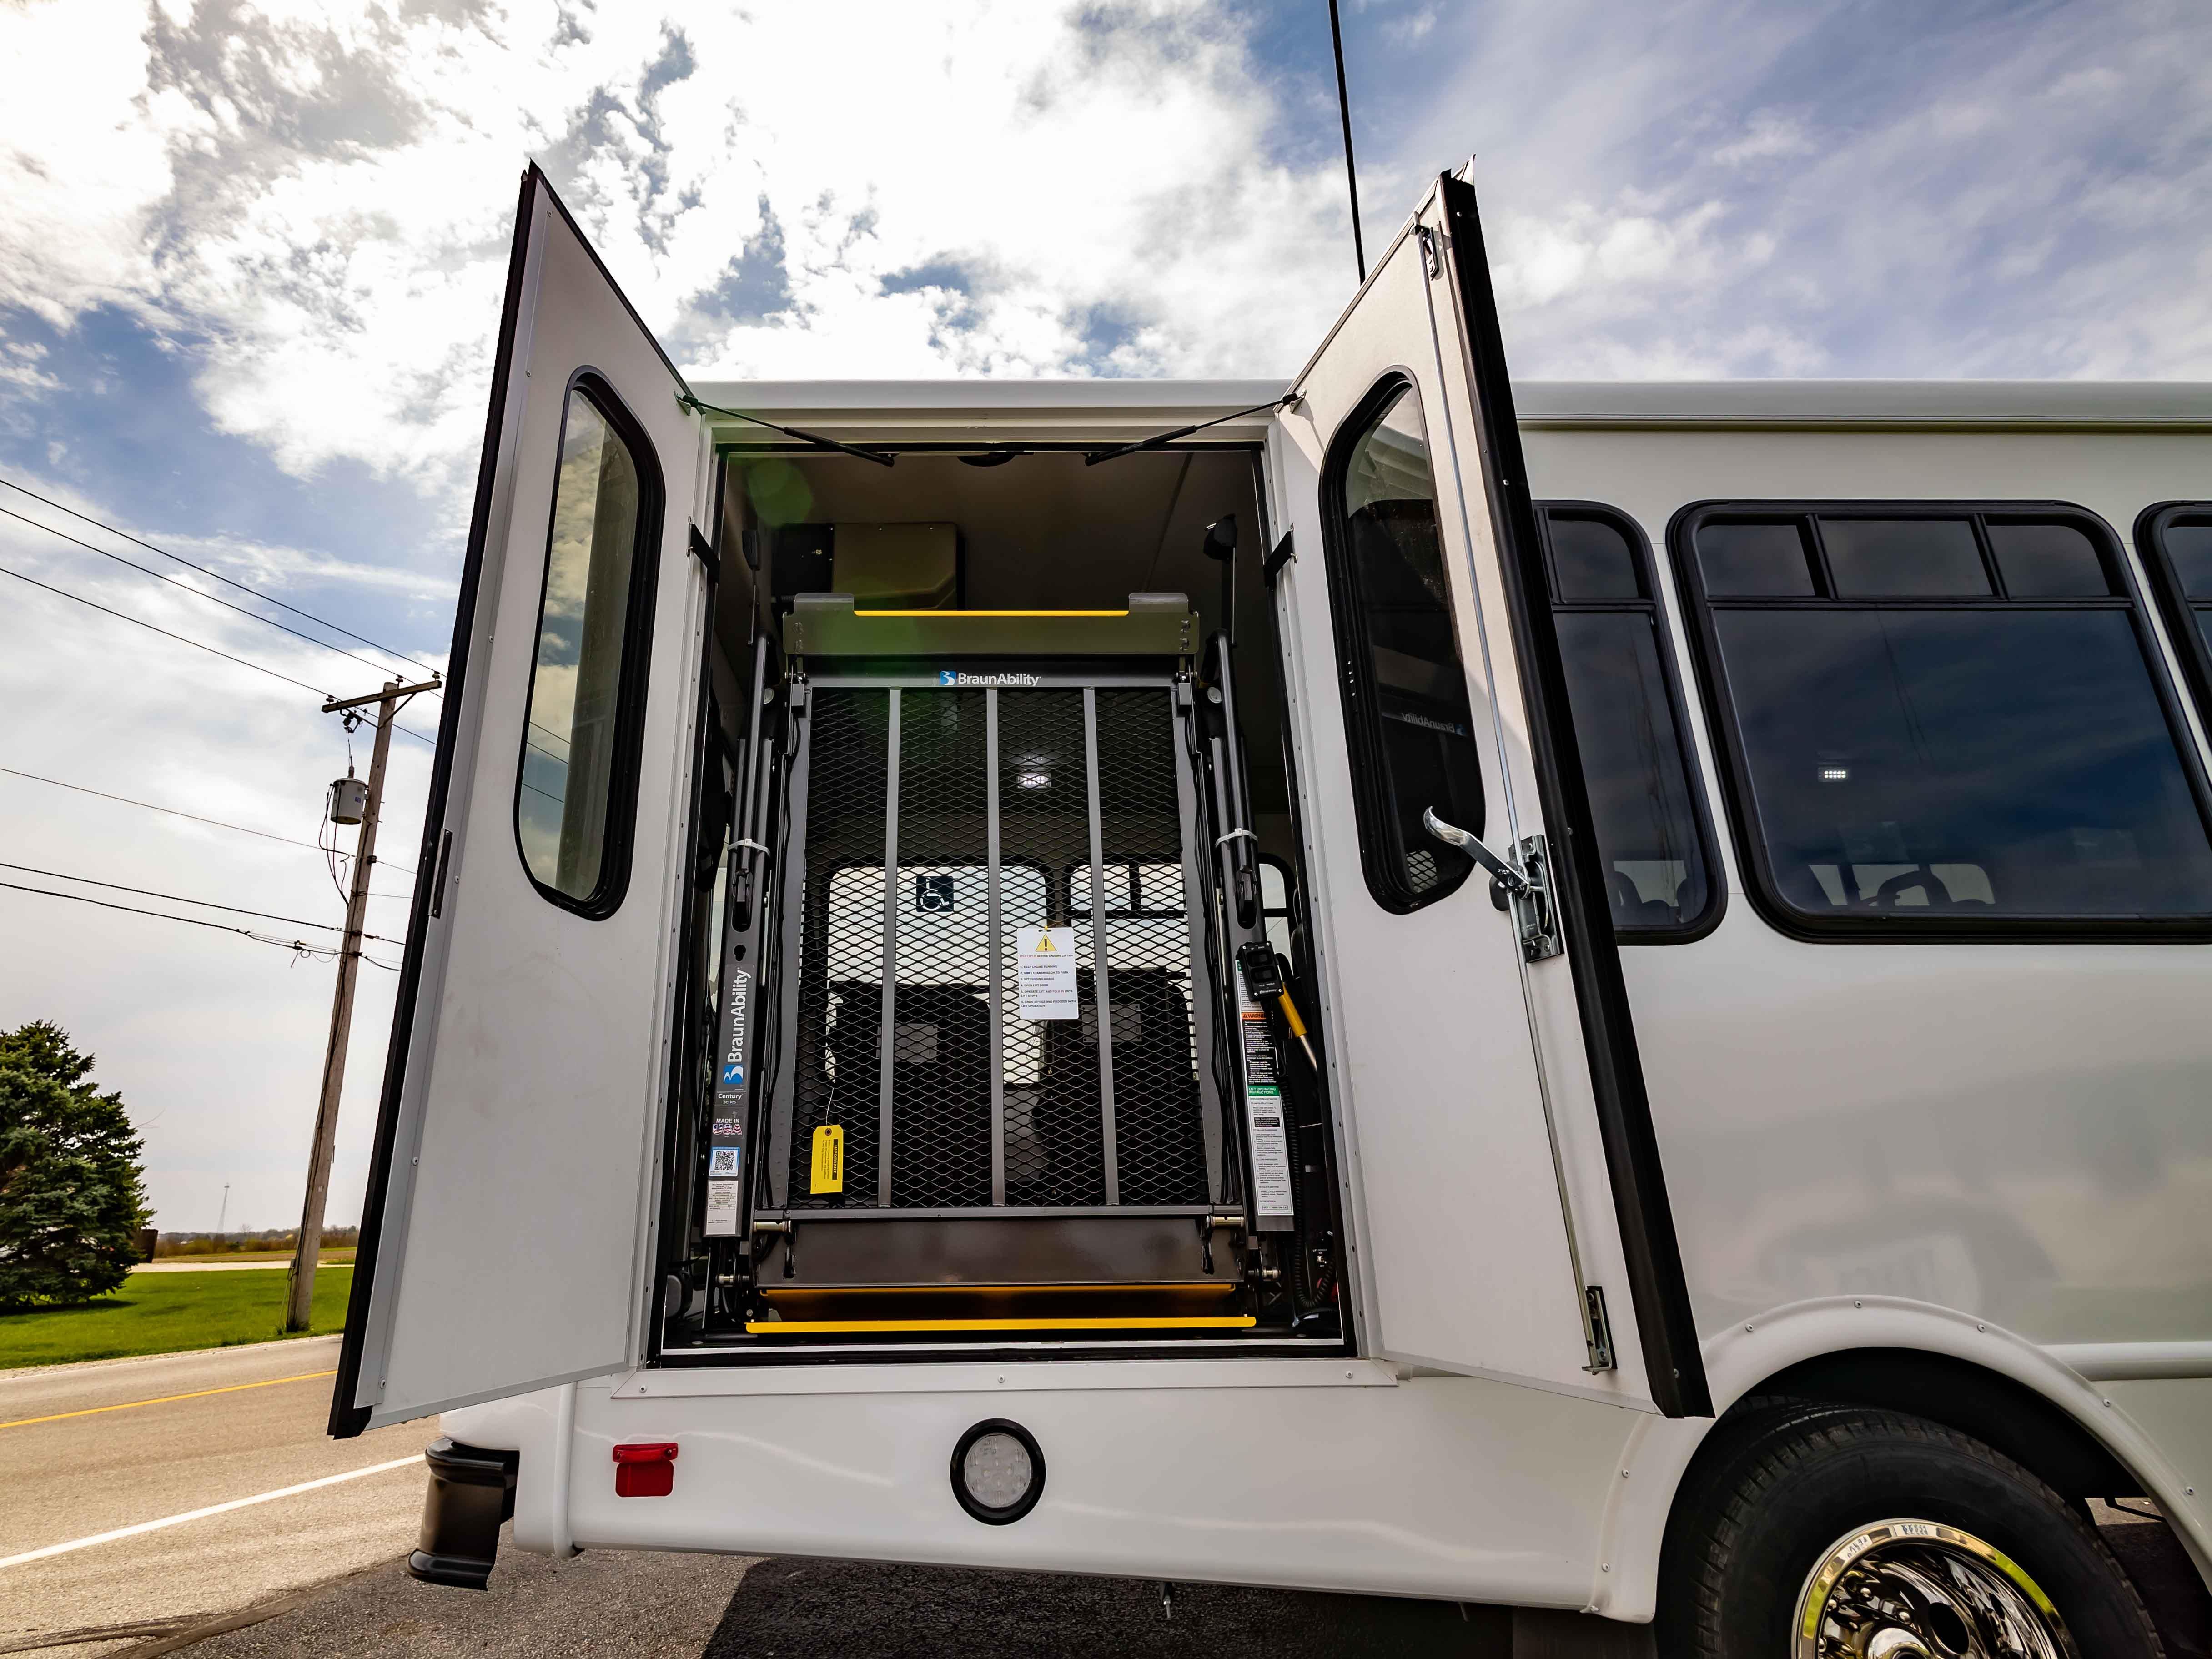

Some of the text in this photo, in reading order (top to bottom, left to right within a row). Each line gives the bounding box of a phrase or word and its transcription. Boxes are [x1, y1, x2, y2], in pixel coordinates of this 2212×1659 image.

[958, 673, 1039, 686] BraunAbility
[727, 969, 751, 1062] BraunAbility
[713, 1123, 743, 1135] USA
